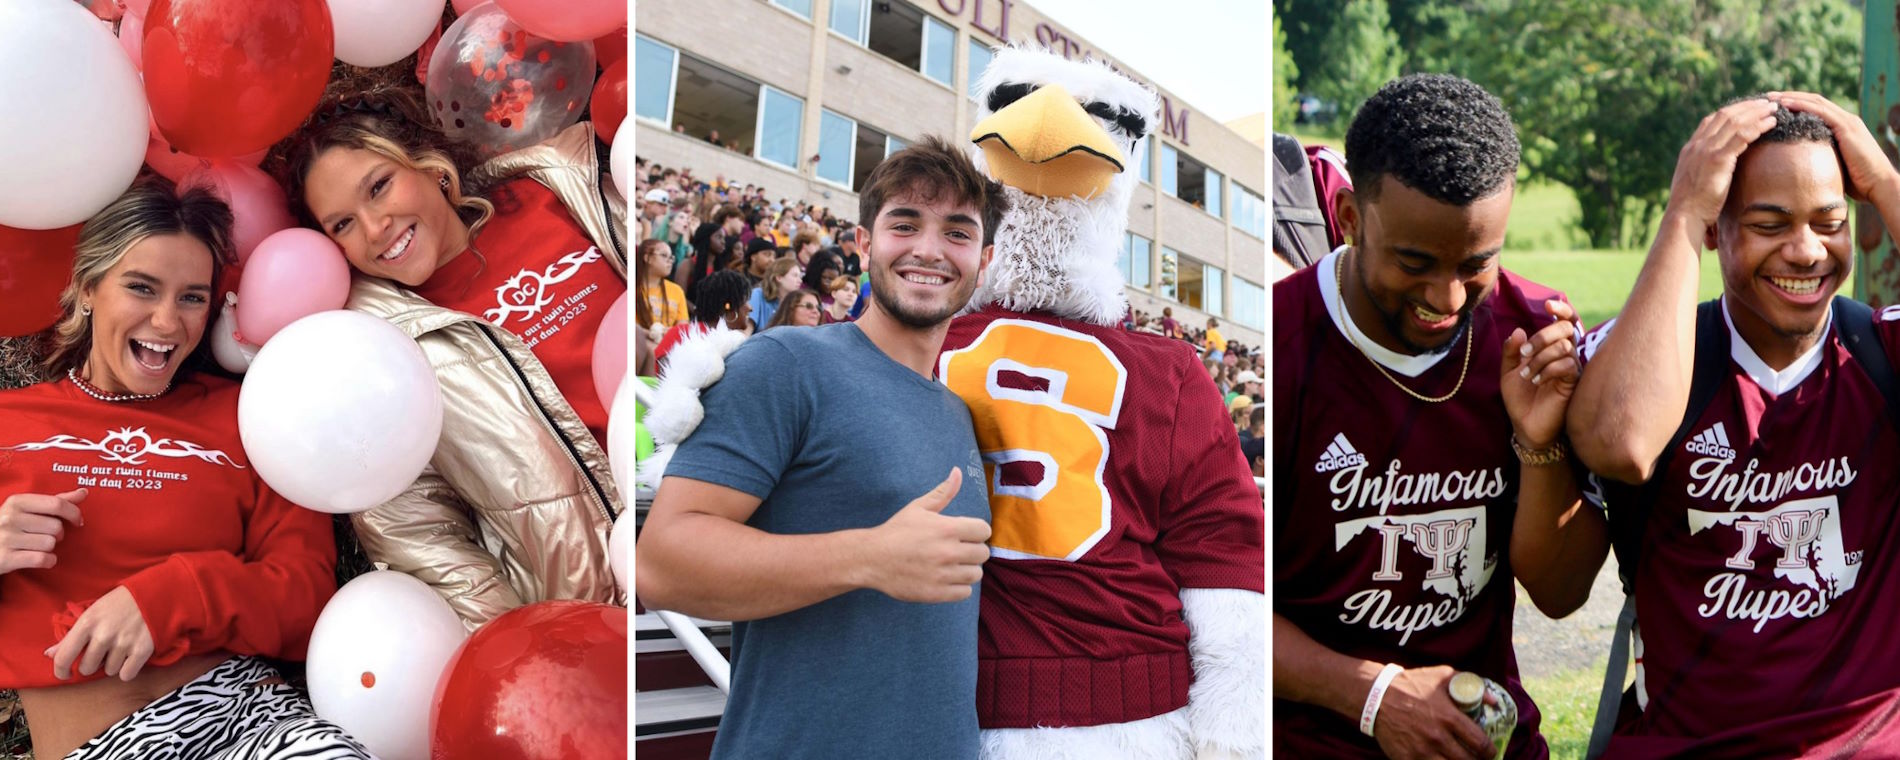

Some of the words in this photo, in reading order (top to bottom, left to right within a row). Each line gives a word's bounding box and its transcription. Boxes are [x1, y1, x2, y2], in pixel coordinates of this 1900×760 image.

[512, 282, 537, 305] DG
[524, 322, 542, 337] our
[541, 304, 565, 325] twin
[563, 283, 598, 307] flames
[526, 336, 540, 350] id
[539, 324, 560, 340] day
[559, 302, 587, 326] 2023
[113, 443, 137, 453] DG
[1315, 452, 1366, 473] adidas
[1685, 440, 1736, 460] adidas
[52, 462, 88, 474] found
[91, 466, 112, 475] our
[115, 466, 142, 477] twin
[146, 469, 188, 481] flames
[77, 475, 96, 487] bid
[100, 477, 122, 489] day
[126, 478, 162, 490] 2023
[1329, 458, 1507, 515] Infamous
[1686, 456, 1858, 513] Infamous
[1338, 589, 1467, 646] Nupes
[1698, 572, 1830, 634] Nupes
